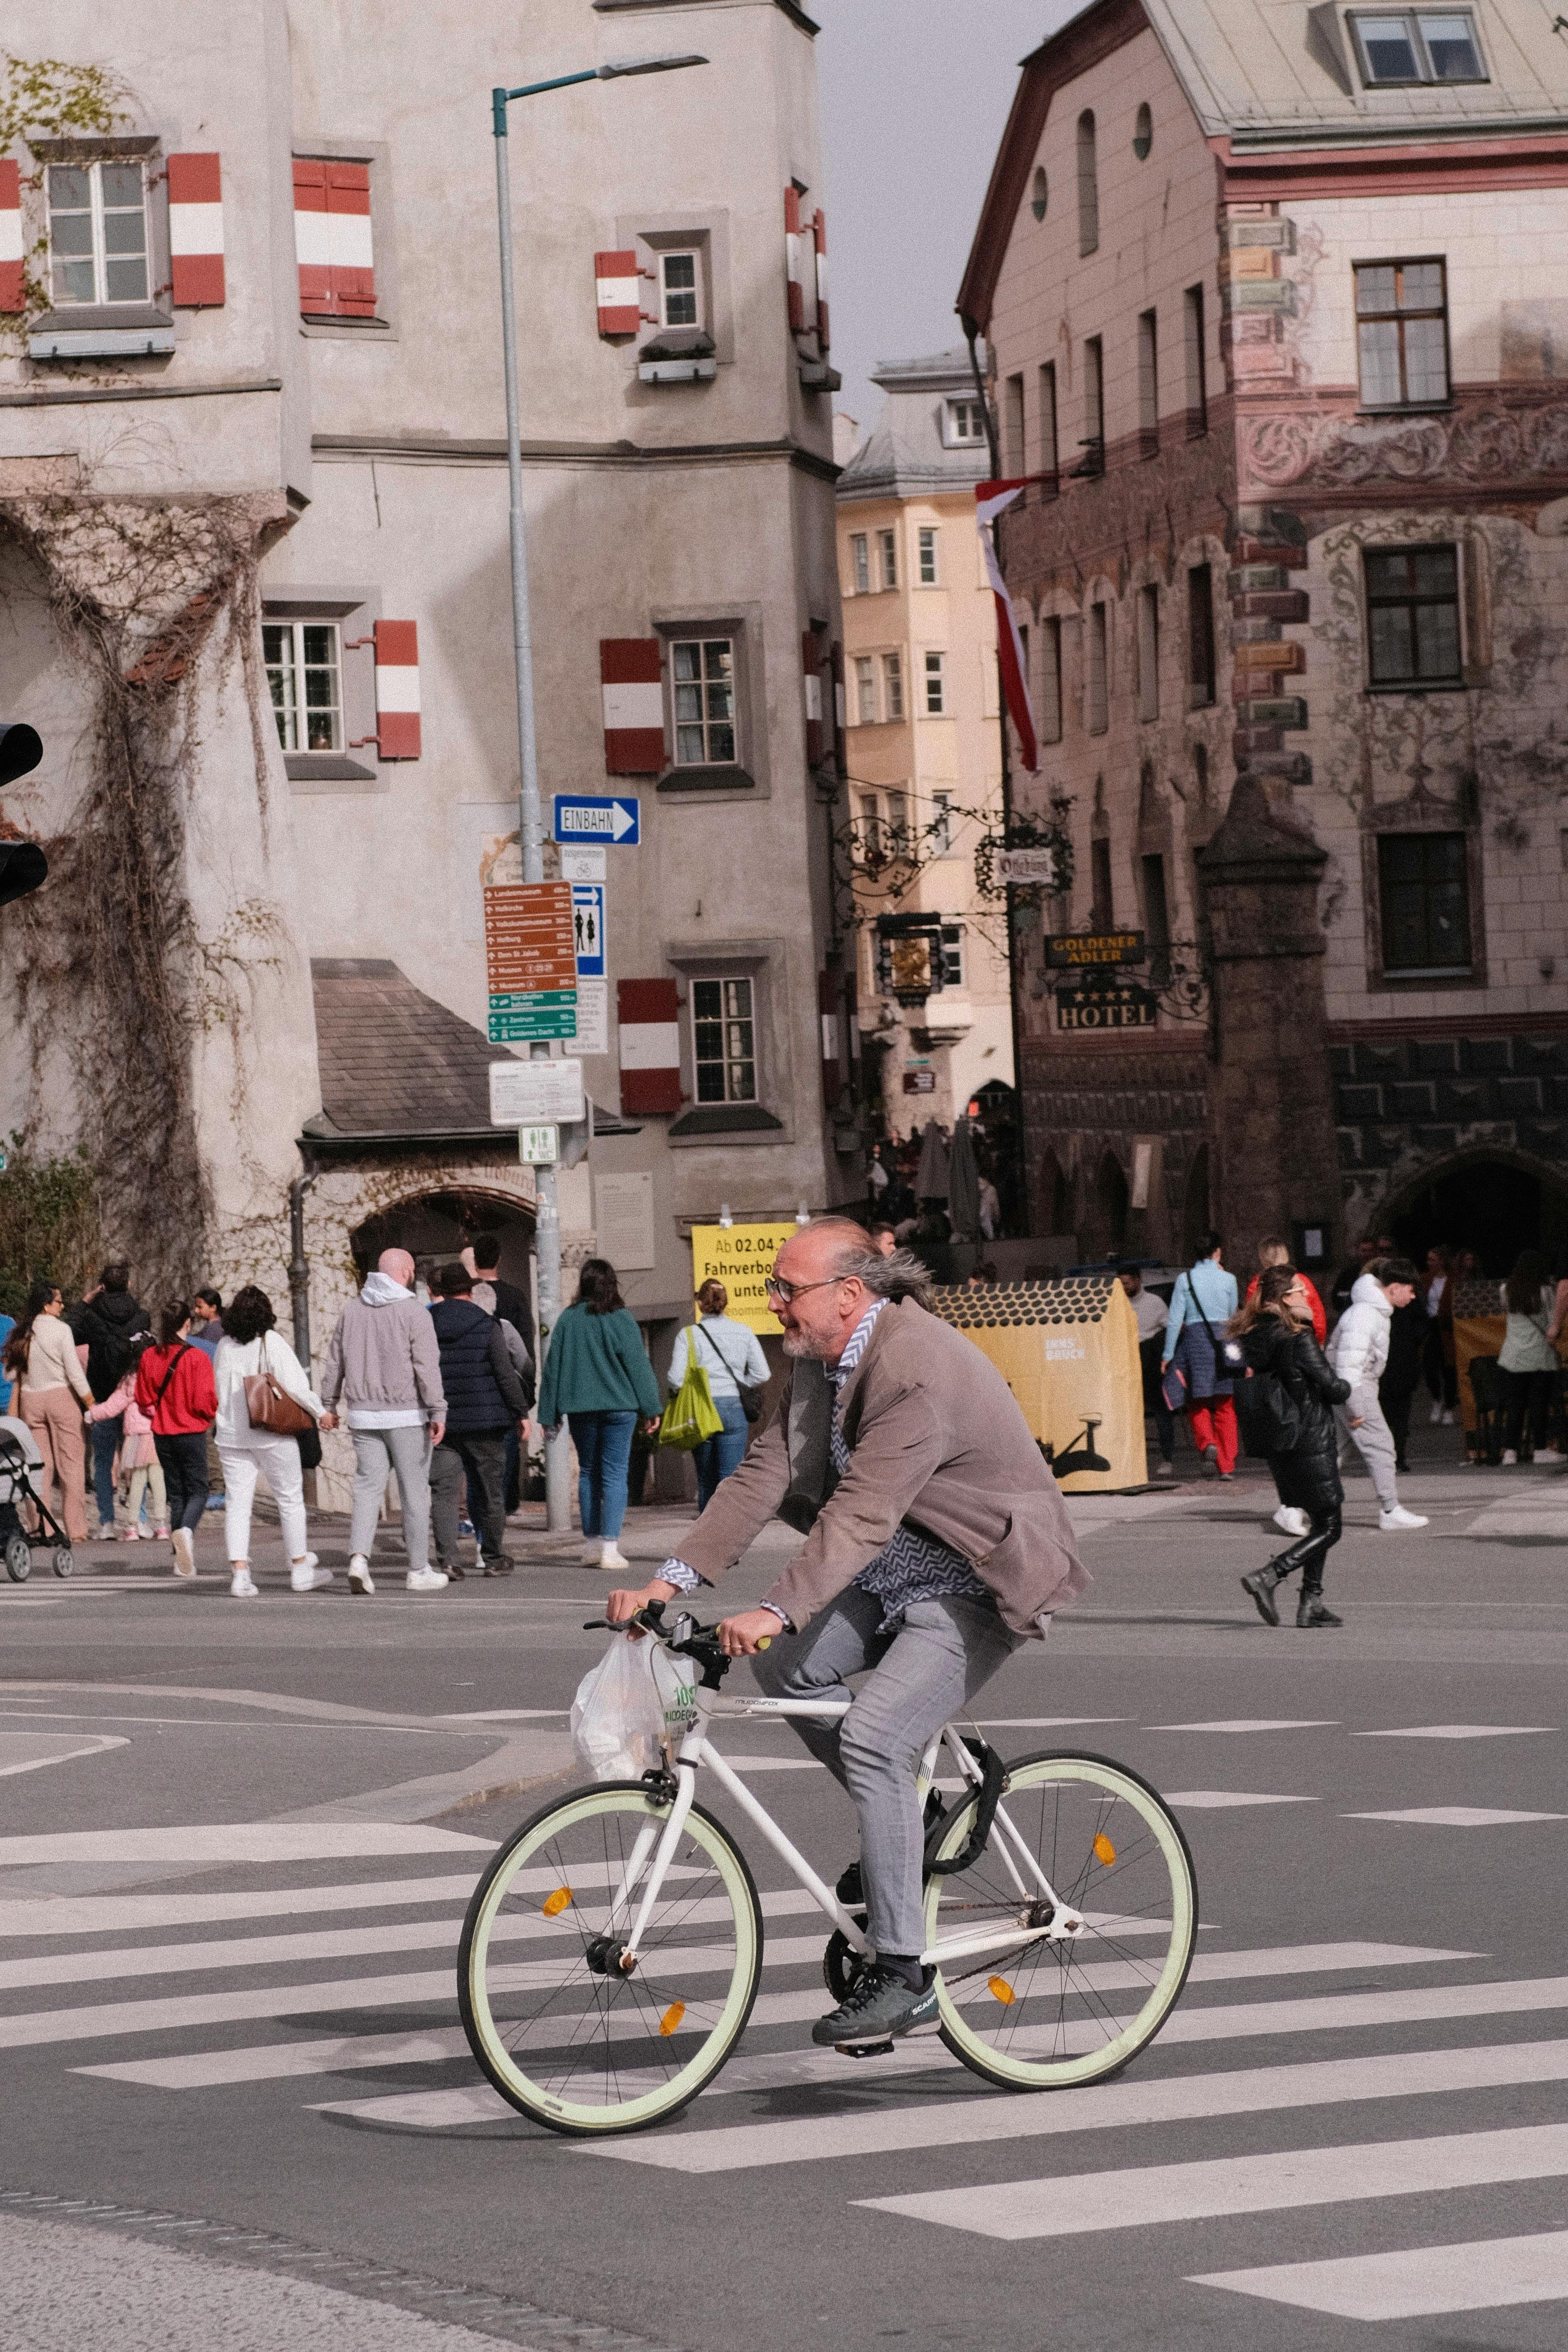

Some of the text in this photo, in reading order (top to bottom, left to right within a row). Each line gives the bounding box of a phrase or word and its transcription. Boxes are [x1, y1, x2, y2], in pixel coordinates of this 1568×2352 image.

[564, 809, 614, 830] EINBAHN
[1053, 935, 1136, 951] GOLDENER
[1067, 950, 1121, 963] ADLER
[1061, 1004, 1155, 1027] HOTEL
[716, 1239, 731, 1253] Ab
[705, 1260, 772, 1276] Fahrverbo
[664, 1709, 694, 1722] BIODEG
